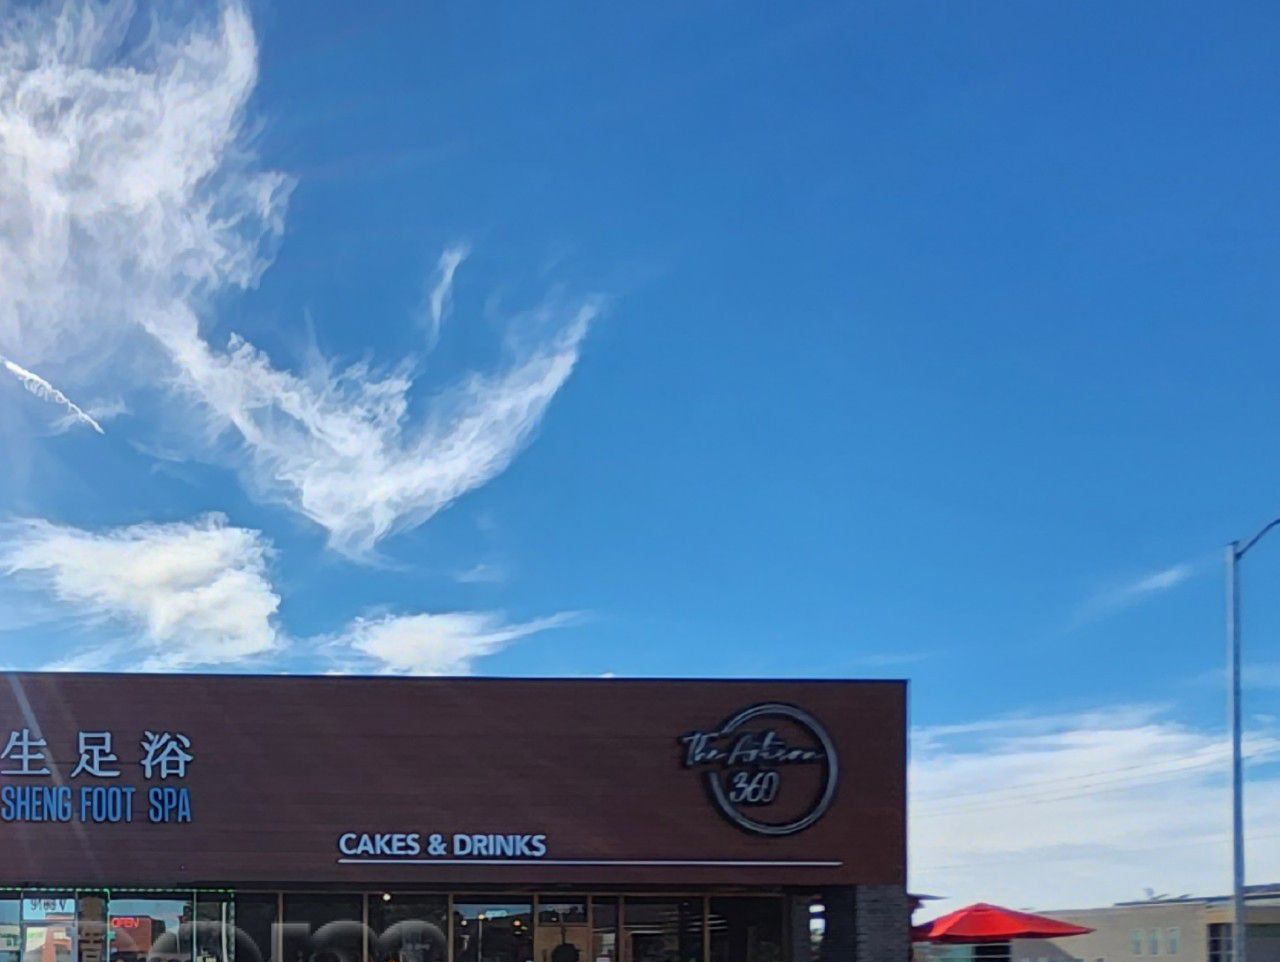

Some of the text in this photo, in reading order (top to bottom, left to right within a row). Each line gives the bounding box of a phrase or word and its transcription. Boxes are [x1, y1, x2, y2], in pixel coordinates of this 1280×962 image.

[729, 771, 780, 803] 360
[0, 784, 72, 823] SHENG
[80, 786, 136, 823] FOOT
[148, 787, 192, 824] SPA
[339, 833, 547, 856] CAKES & DRINKS
